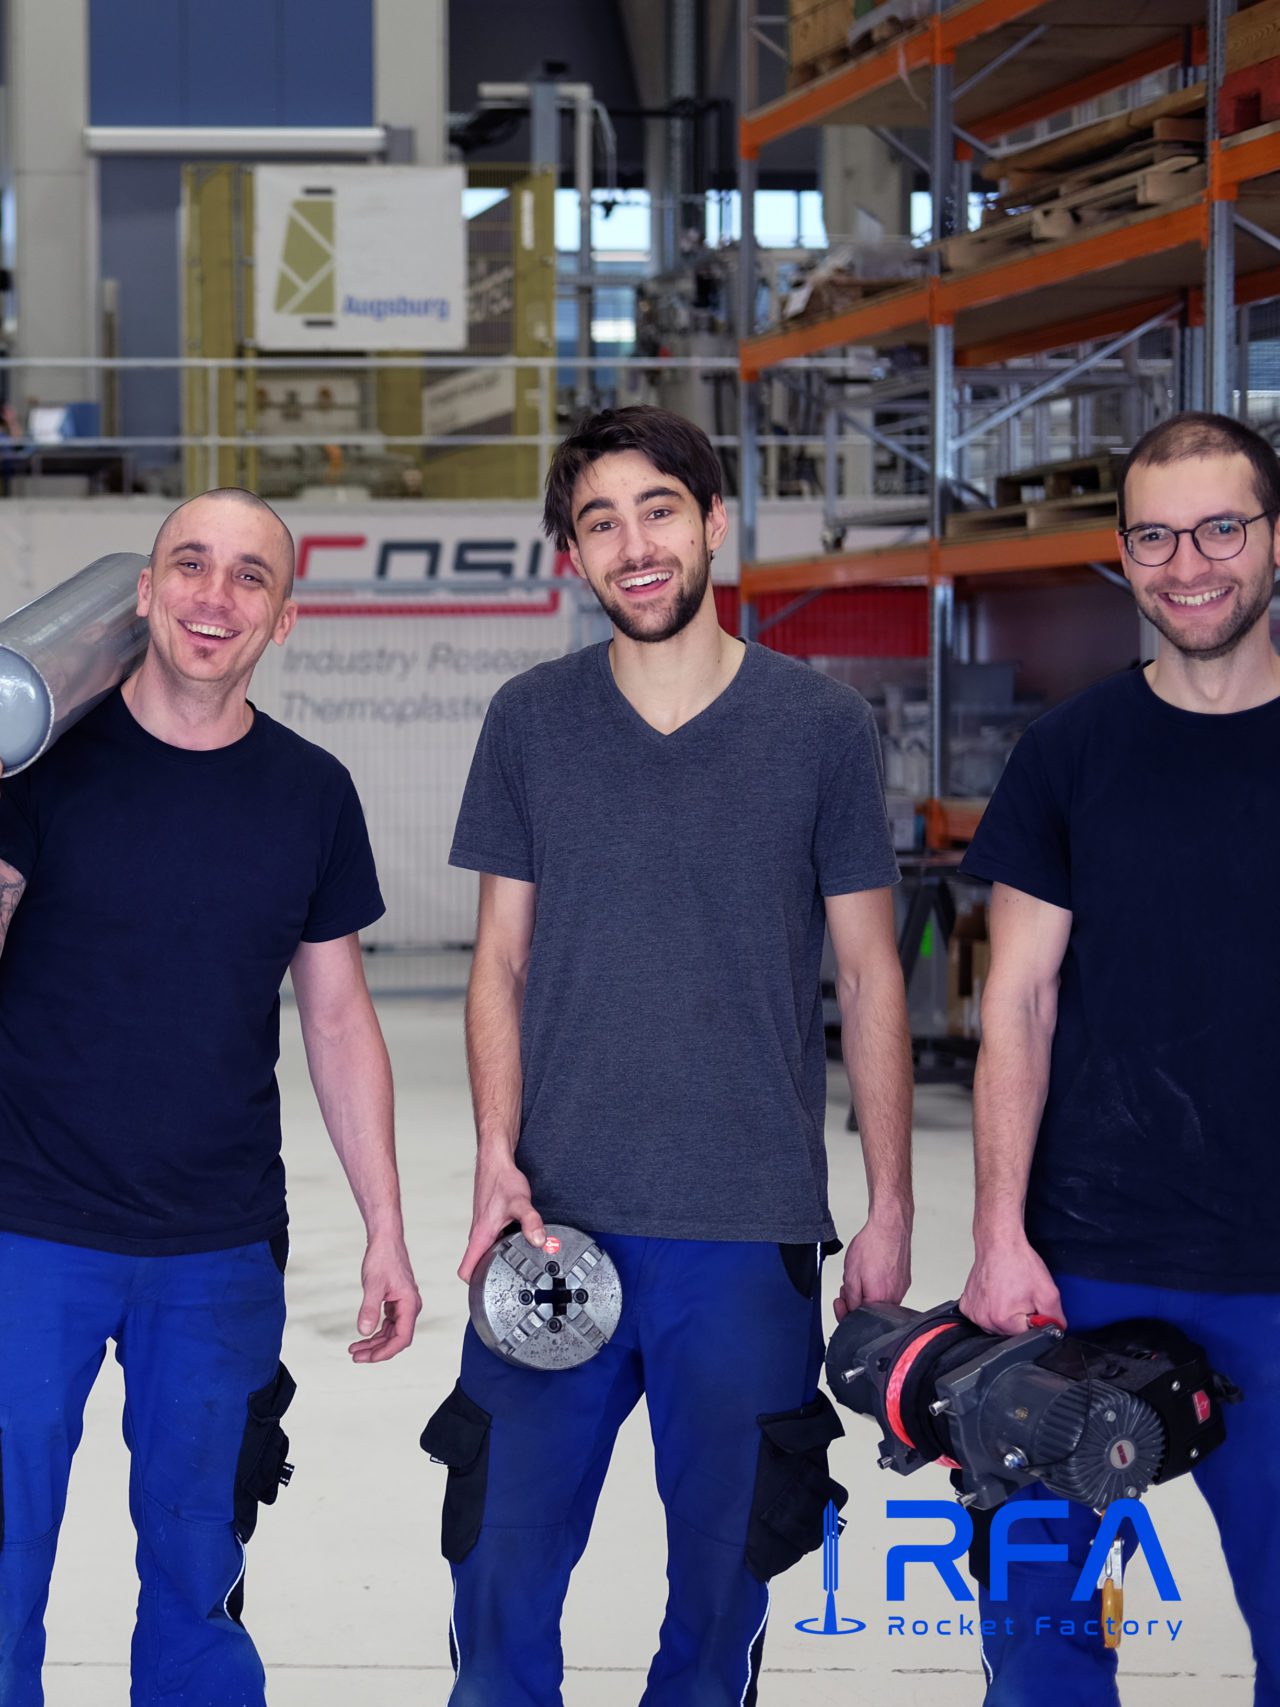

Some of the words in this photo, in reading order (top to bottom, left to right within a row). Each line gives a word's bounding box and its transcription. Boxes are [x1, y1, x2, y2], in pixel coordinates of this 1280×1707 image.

[343, 295, 450, 321] Augsburg
[282, 643, 417, 681] Industry
[281, 691, 489, 727] Thermoplasti
